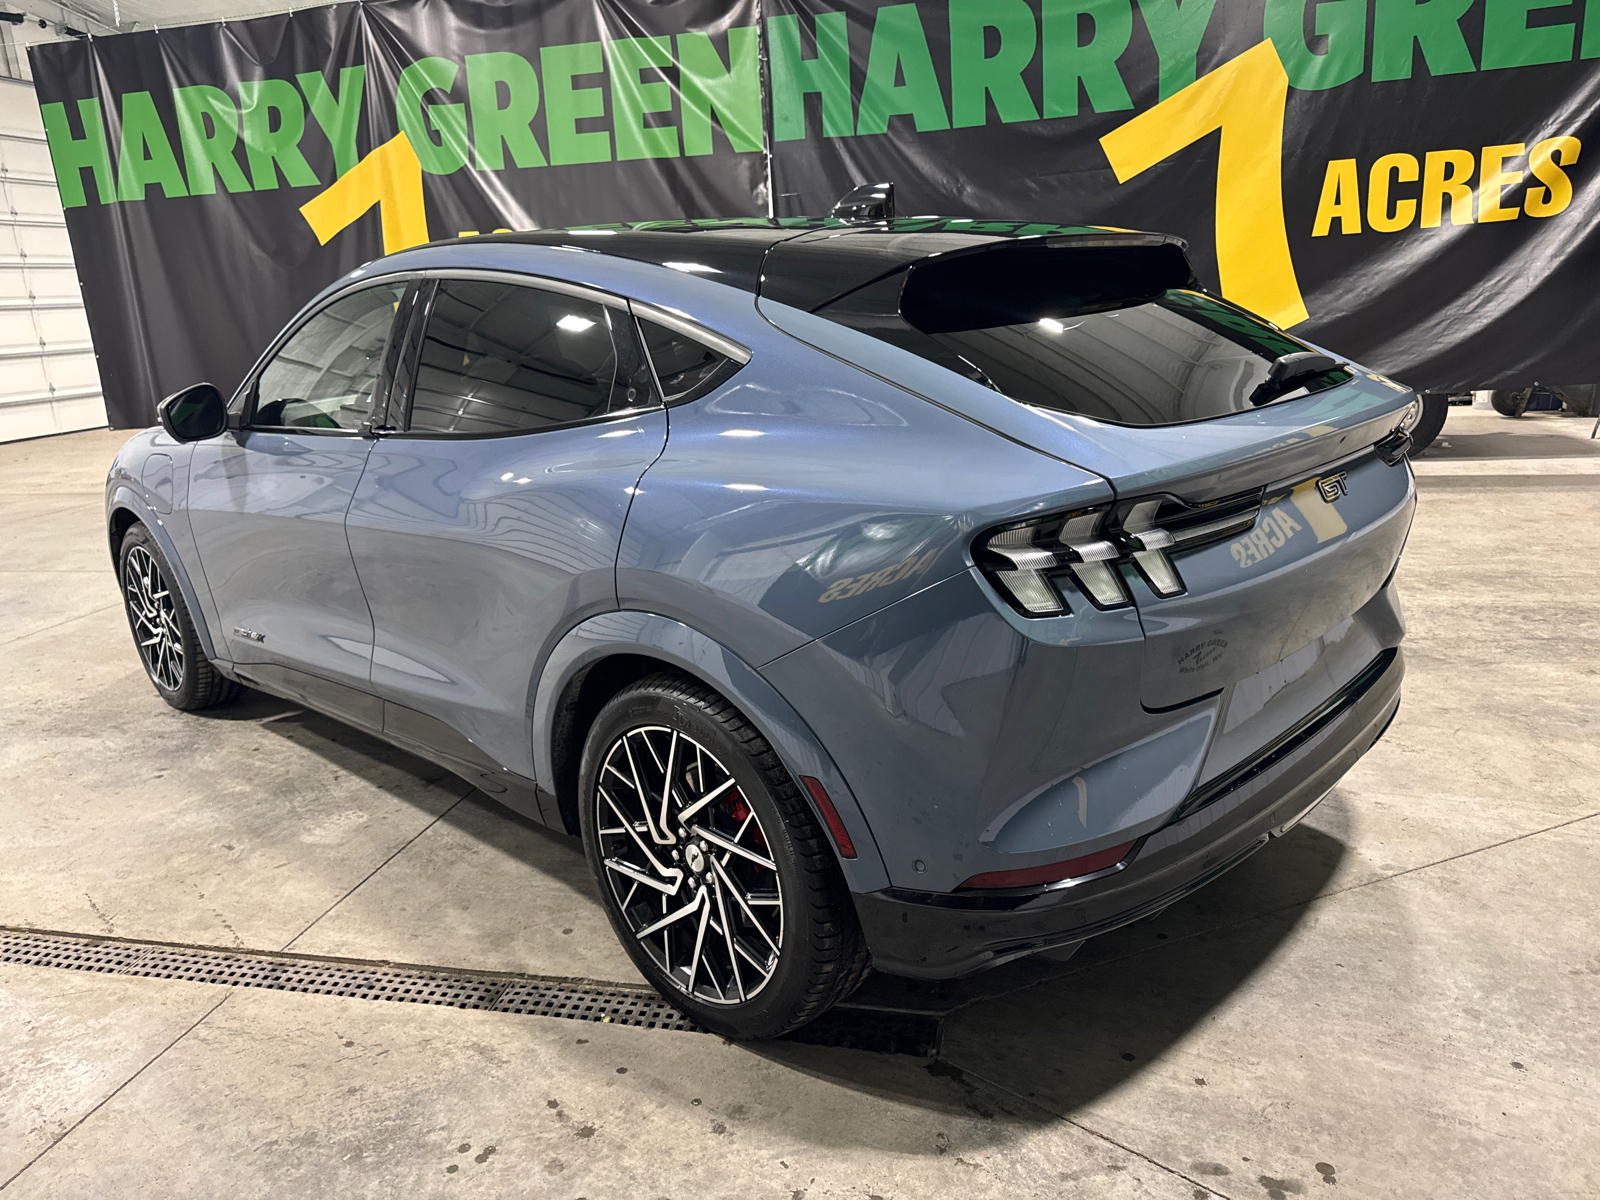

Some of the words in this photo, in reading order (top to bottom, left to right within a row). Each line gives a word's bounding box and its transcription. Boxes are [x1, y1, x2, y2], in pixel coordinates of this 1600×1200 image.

[39, 65, 366, 209] HARRY
[397, 25, 765, 175] GREEN
[768, 0, 1214, 142] HARRY
[1099, 38, 1310, 330] 7
[1312, 136, 1582, 237] ACRES
[1315, 471, 1348, 504] GT
[1177, 641, 1206, 666] HARRY
[1207, 638, 1229, 649] GREEN
